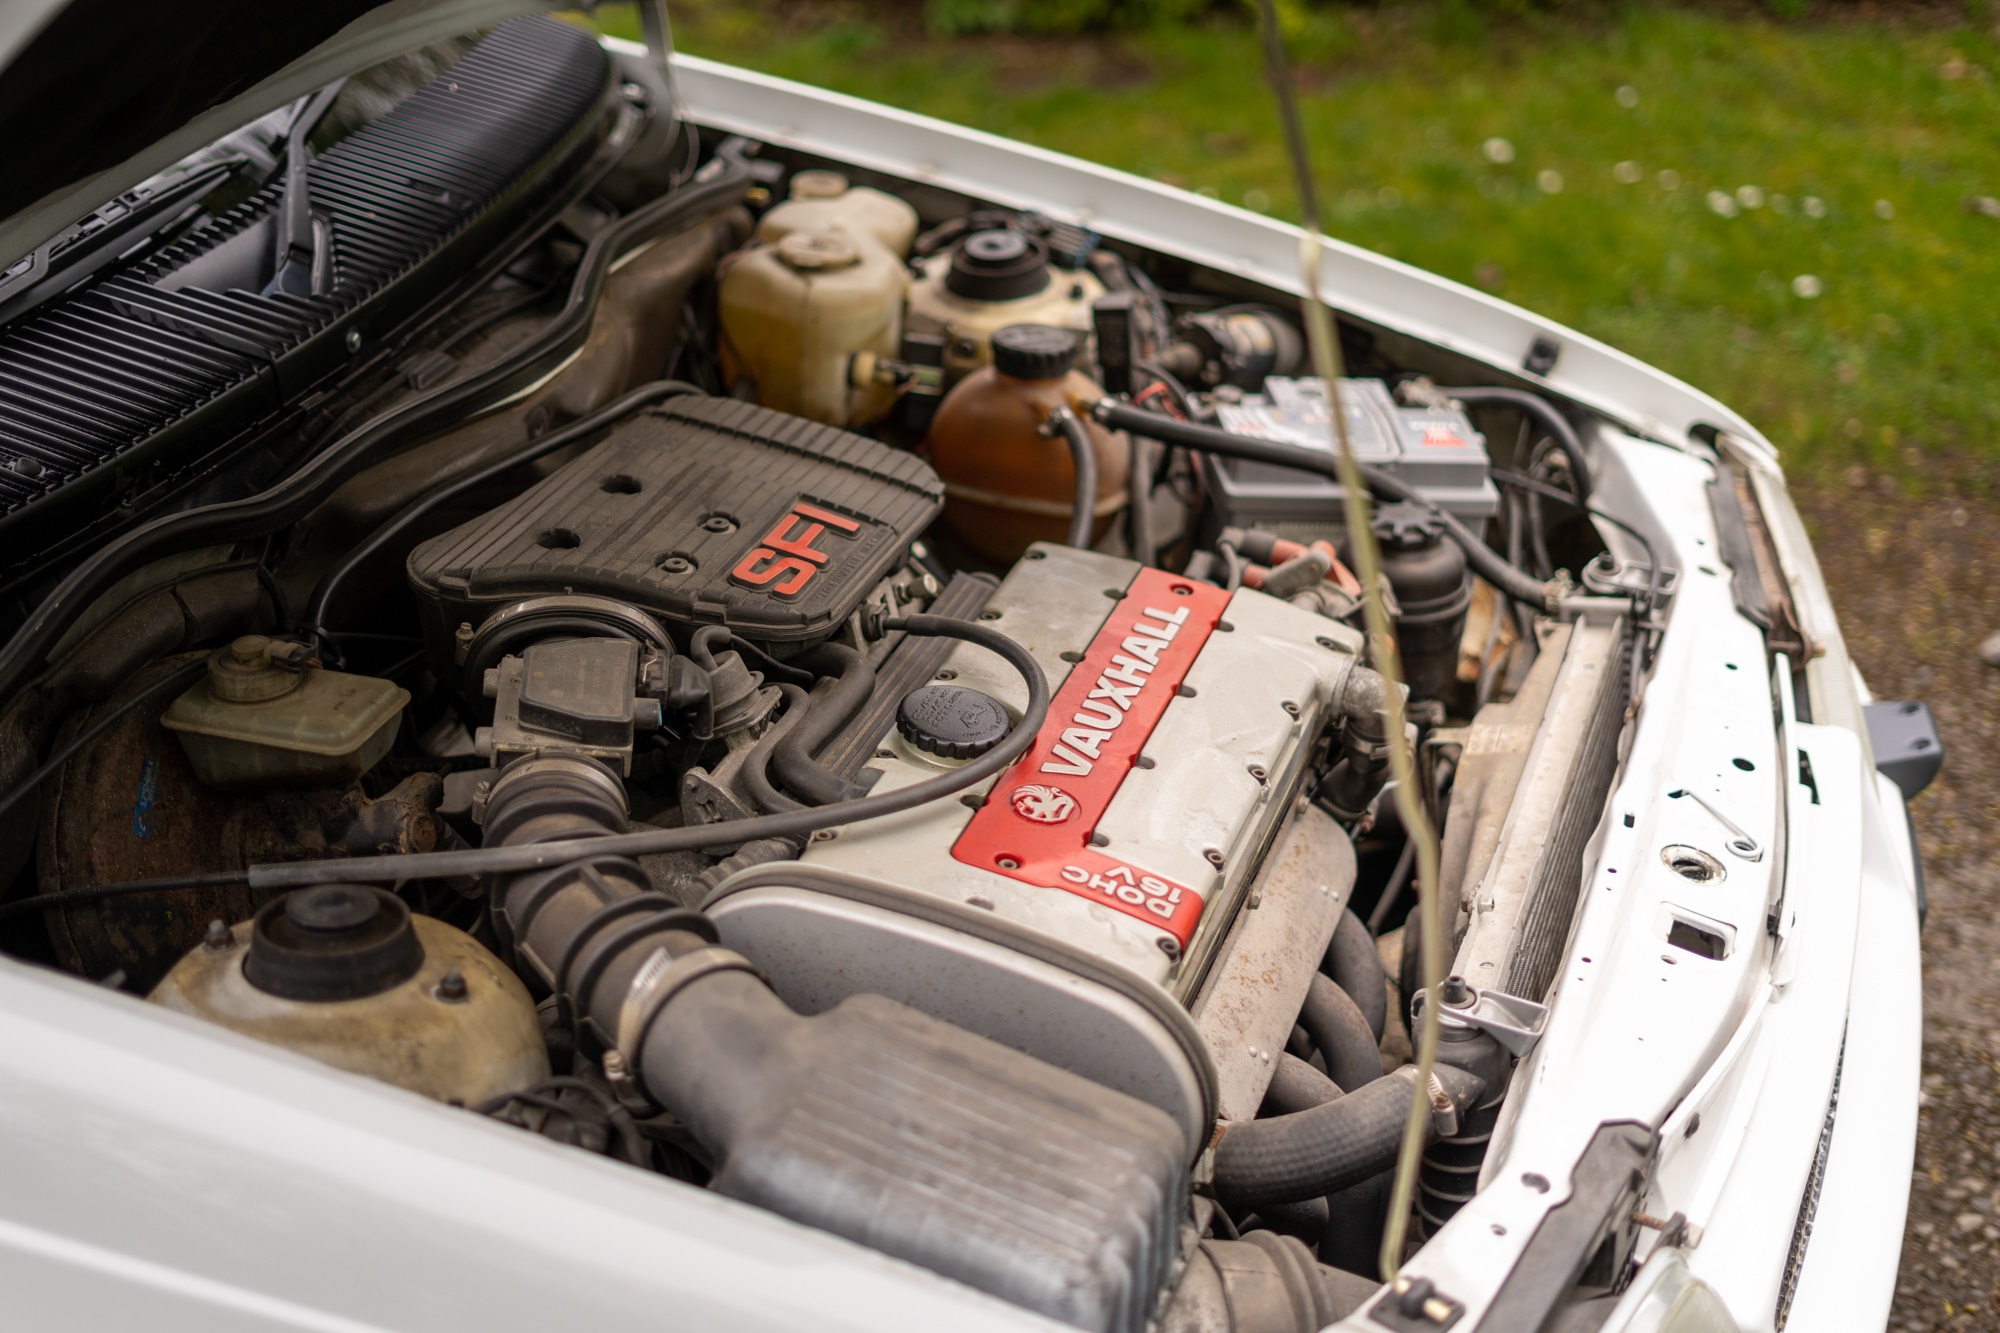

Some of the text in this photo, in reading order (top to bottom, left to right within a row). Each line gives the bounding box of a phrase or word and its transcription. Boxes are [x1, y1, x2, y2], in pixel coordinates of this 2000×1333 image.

[732, 503, 861, 595] SFI
[1040, 605, 1190, 777] VAUXHALL
[1061, 865, 1176, 919] DOHC
[1104, 865, 1182, 903] 16V
